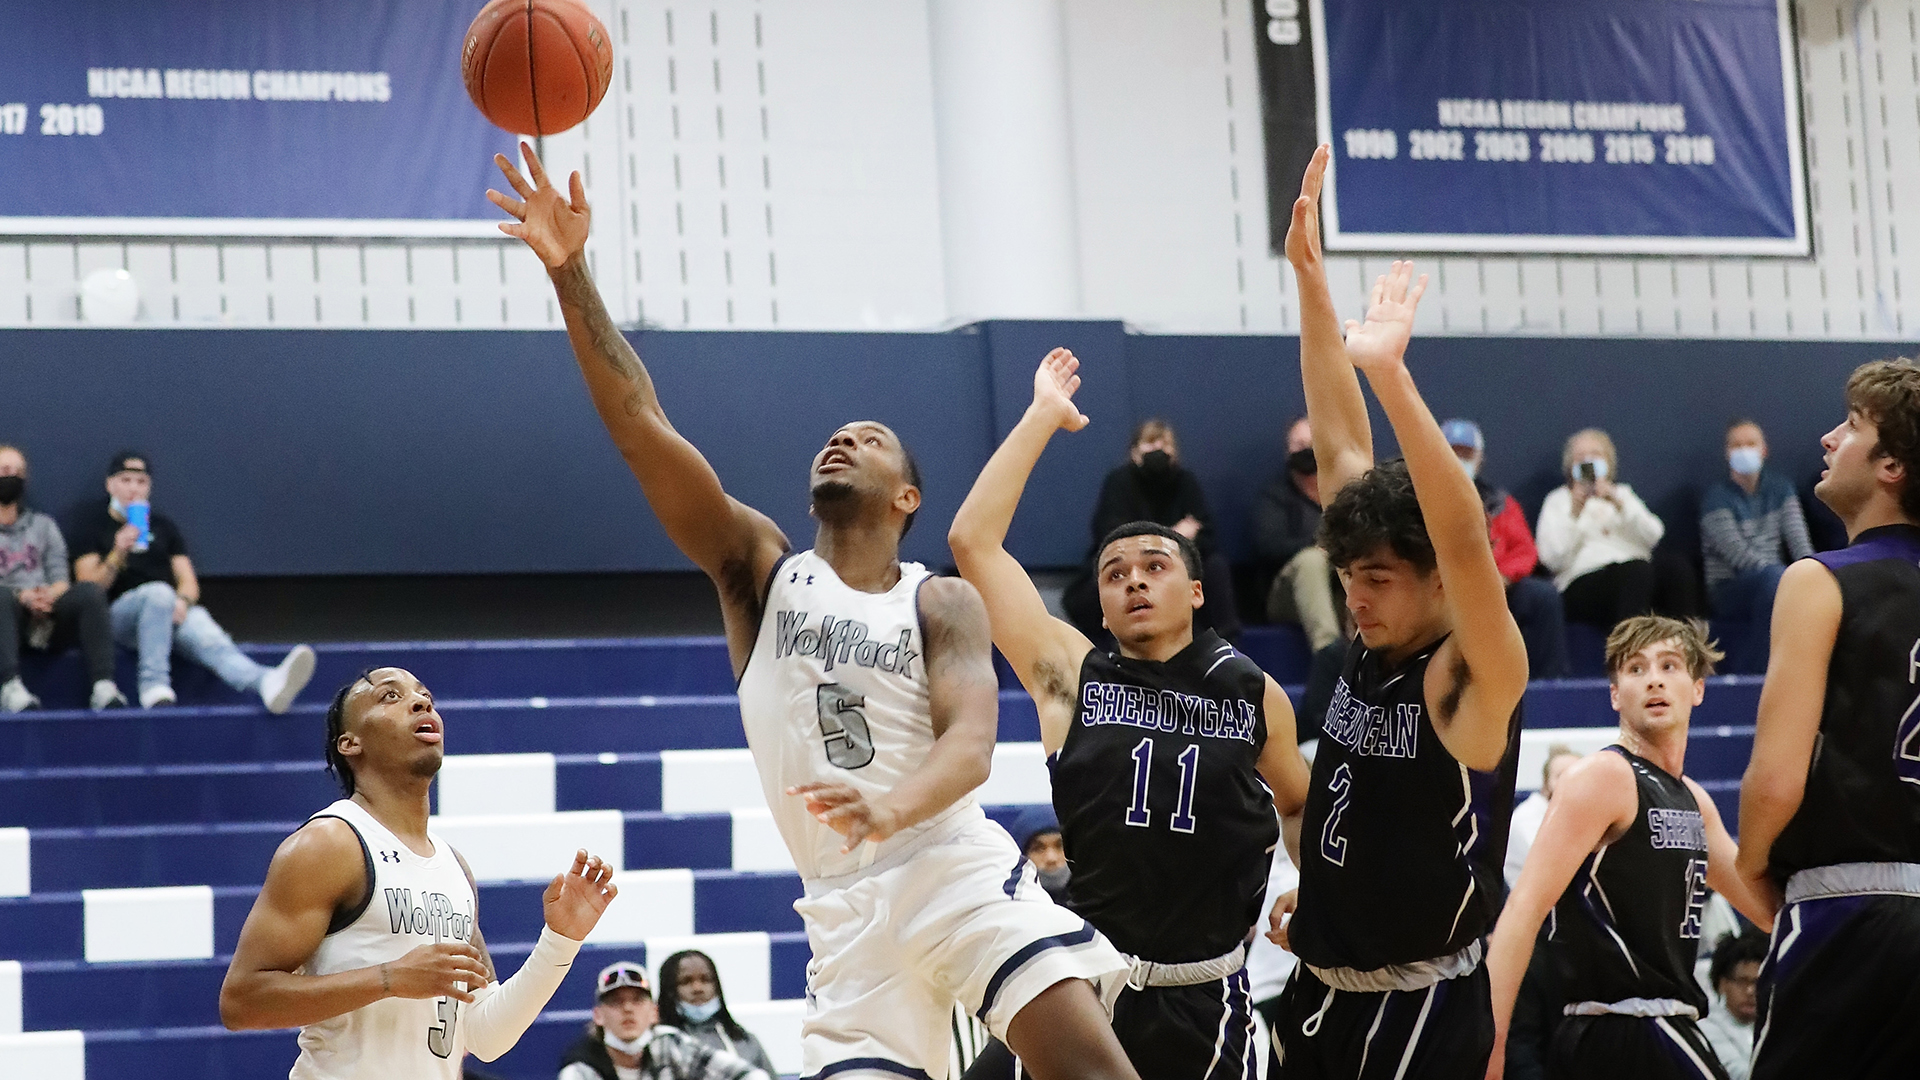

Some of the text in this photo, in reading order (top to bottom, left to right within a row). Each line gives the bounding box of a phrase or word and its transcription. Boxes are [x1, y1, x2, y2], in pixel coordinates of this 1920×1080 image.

[164, 68, 250, 100] REGION
[252, 70, 390, 103] CHAMPIONS
[1573, 101, 1686, 132] CHAMPIONS
[39, 103, 104, 136] 2019
[775, 610, 919, 680] WolfPack
[817, 683, 875, 770] 5
[1082, 681, 1256, 746] SHEBOYGAN
[1125, 737, 1199, 834] 11
[1320, 762, 1353, 867] 2
[384, 887, 474, 943] WolfPac
